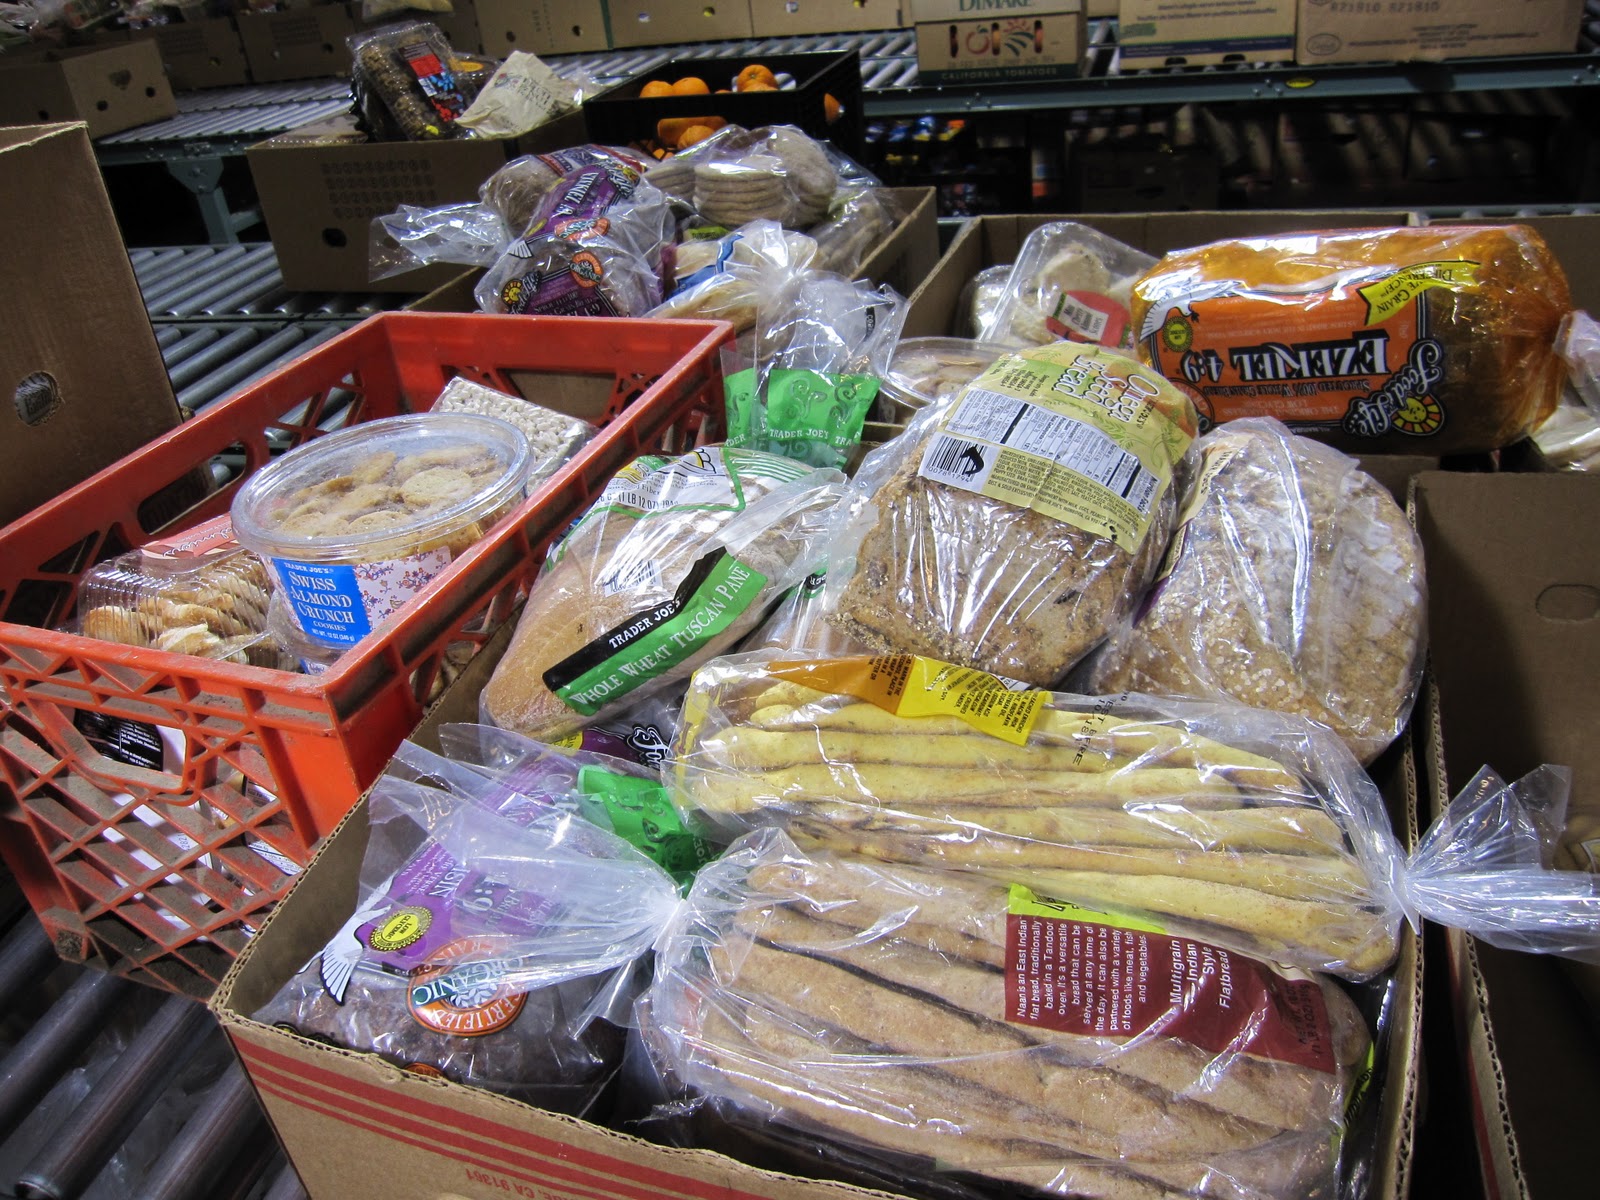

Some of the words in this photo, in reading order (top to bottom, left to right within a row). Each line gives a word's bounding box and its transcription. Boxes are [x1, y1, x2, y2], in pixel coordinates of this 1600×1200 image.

[1375, 282, 1411, 315] GRAIN
[1181, 350, 1223, 383] 4:9
[1230, 333, 1389, 381] EZEKIEL
[1052, 355, 1105, 398] Bread
[1081, 370, 1127, 407] Seed
[1103, 375, 1159, 424] Omega
[1349, 399, 1392, 435] Life
[769, 429, 802, 437] TRADER
[626, 493, 638, 504] LB
[637, 497, 646, 508] 12
[1135, 496, 1149, 513] Facts
[283, 561, 308, 571] TRADER
[308, 566, 329, 574] JOE'S
[287, 571, 337, 592] SWISS
[288, 585, 353, 609] ALMOND
[295, 601, 356, 624] CRUNCH
[312, 620, 346, 631] COOKIES
[609, 618, 653, 649] TRADER
[653, 599, 681, 622] JOE'S
[569, 674, 624, 707] WHOLE
[618, 646, 672, 677] WHEAT
[670, 597, 726, 650] TUSCAN
[719, 565, 751, 602] PANE
[887, 675, 897, 690] PLACE
[899, 666, 909, 680] WARM
[893, 686, 901, 696] THE
[384, 913, 411, 940] GLYCEMIC
[398, 921, 412, 935] LOW
[1018, 919, 1026, 946] Indian
[1071, 925, 1080, 934] be
[1084, 925, 1092, 933] of
[1098, 927, 1106, 937] be
[1030, 920, 1041, 974] traditionally
[1043, 921, 1053, 960] Tandoor
[1058, 923, 1066, 962] versatile
[1084, 936, 1092, 956] time
[1111, 929, 1121, 956] variety
[1124, 931, 1133, 944] fish
[1016, 949, 1026, 970] East
[1097, 940, 1106, 960] also
[1124, 947, 1134, 973] meat,
[1071, 958, 1079, 977] that
[1085, 960, 1094, 978] any
[1169, 939, 1181, 1004] Multigrain
[1187, 943, 1197, 984] Indian
[1203, 946, 1214, 976] Style
[413, 956, 525, 1006] ORGANIC
[1018, 973, 1025, 983] an
[1043, 973, 1051, 981] in
[1057, 974, 1065, 987] It's
[1098, 963, 1106, 981] can
[1110, 968, 1119, 986] with
[1218, 950, 1231, 1009] Flatbread
[1030, 977, 1039, 1001] bread,
[1070, 979, 1080, 1004] bread
[1084, 980, 1092, 988] at
[1123, 976, 1132, 991] like
[1138, 984, 1146, 1002] and
[1017, 993, 1026, 1016] Naan
[1043, 983, 1053, 1008] baked
[1096, 994, 1106, 1013] day.
[1122, 993, 1132, 1018] foods
[1030, 1003, 1039, 1019] flat
[1083, 990, 1092, 1024] served
[1109, 988, 1119, 1030] partnered
[1095, 1016, 1104, 1030] the
[1122, 1020, 1130, 1029] of
[464, 1168, 511, 1191] 91361
[511, 1181, 536, 1198] CA
